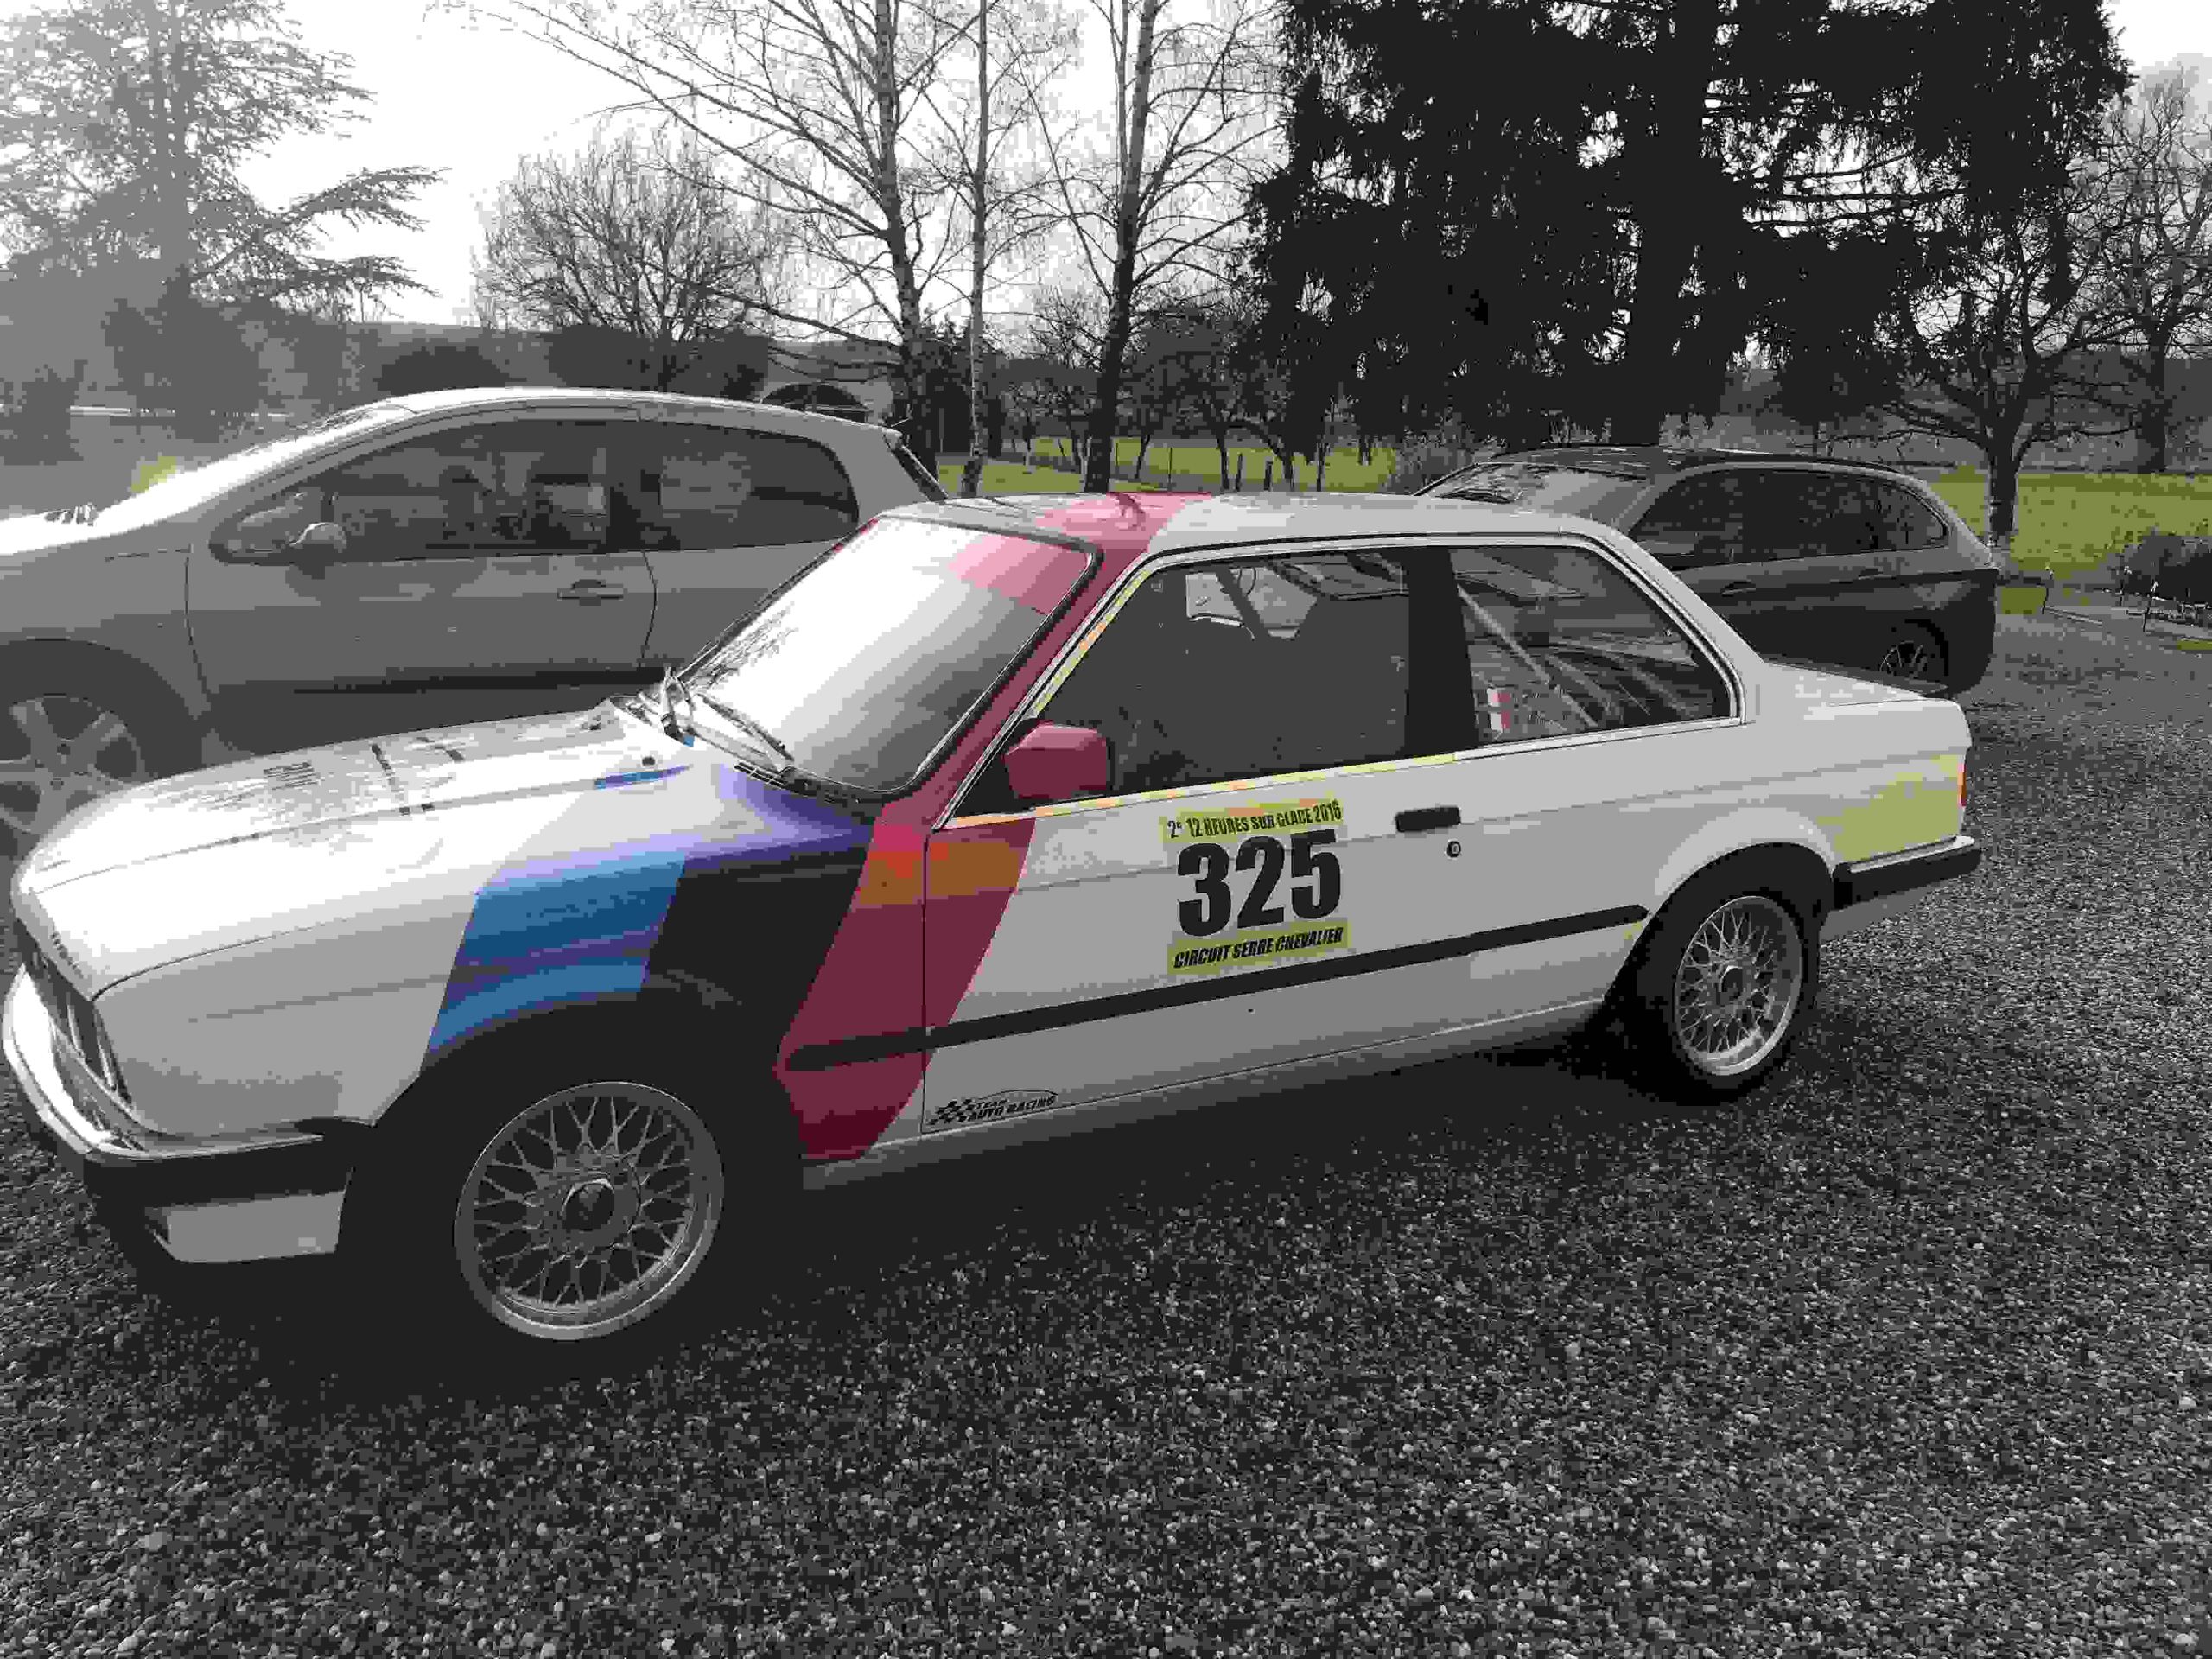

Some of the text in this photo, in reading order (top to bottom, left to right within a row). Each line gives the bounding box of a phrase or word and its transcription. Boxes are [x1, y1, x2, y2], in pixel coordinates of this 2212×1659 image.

[1186, 817, 1204, 838] 12
[1204, 816, 1250, 836] HEURES
[1252, 814, 1274, 830] SUR
[1276, 807, 1313, 828] GLACE
[1313, 799, 1343, 822] 2016
[1178, 829, 1340, 936] 325
[1173, 927, 1344, 968] CIRCUIT SERRE CHEVALIER
[1007, 1096, 1057, 1113] RACING
